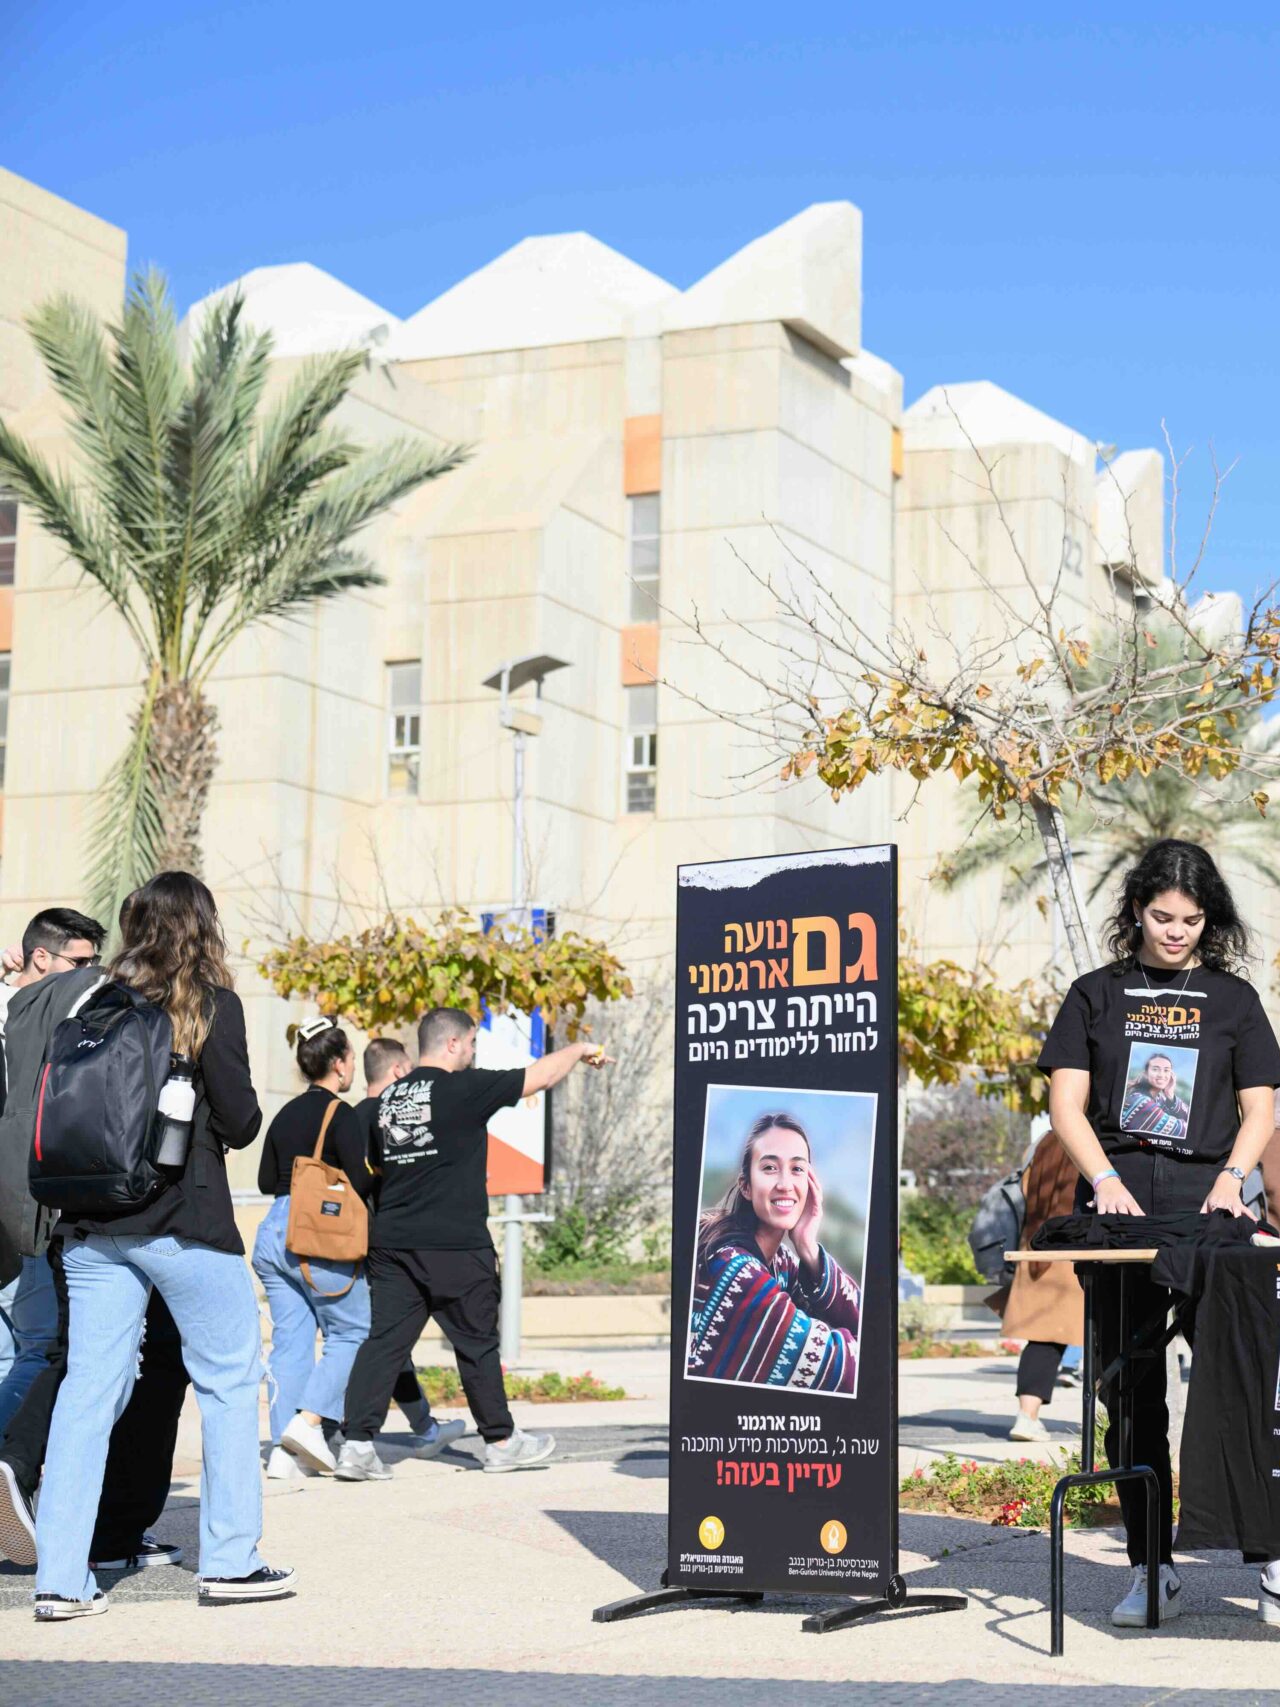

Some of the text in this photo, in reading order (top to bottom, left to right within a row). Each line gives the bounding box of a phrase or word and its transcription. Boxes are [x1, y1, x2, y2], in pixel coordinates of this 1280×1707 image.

[724, 919, 788, 954] נועה
[792, 912, 878, 987] גם
[688, 957, 789, 994] ארגמני
[687, 991, 877, 1035] הייתה צריכה
[1168, 1007, 1200, 1025] גם
[1125, 1021, 1161, 1033] צריכה
[688, 1026, 878, 1062] לחזור ללימודים היום
[737, 1415, 821, 1432] נועה ארגמני
[681, 1436, 724, 1453] ותוכנה
[727, 1437, 762, 1454] מידע
[765, 1437, 829, 1455] במערכות
[851, 1438, 880, 1455] שנה
[716, 1459, 842, 1493] עדיין בעזה!
[789, 1557, 805, 1566] בנגב
[837, 1558, 879, 1568] אוניברסיטת
[819, 1569, 844, 1578] University
[862, 1571, 878, 1579] Negev
